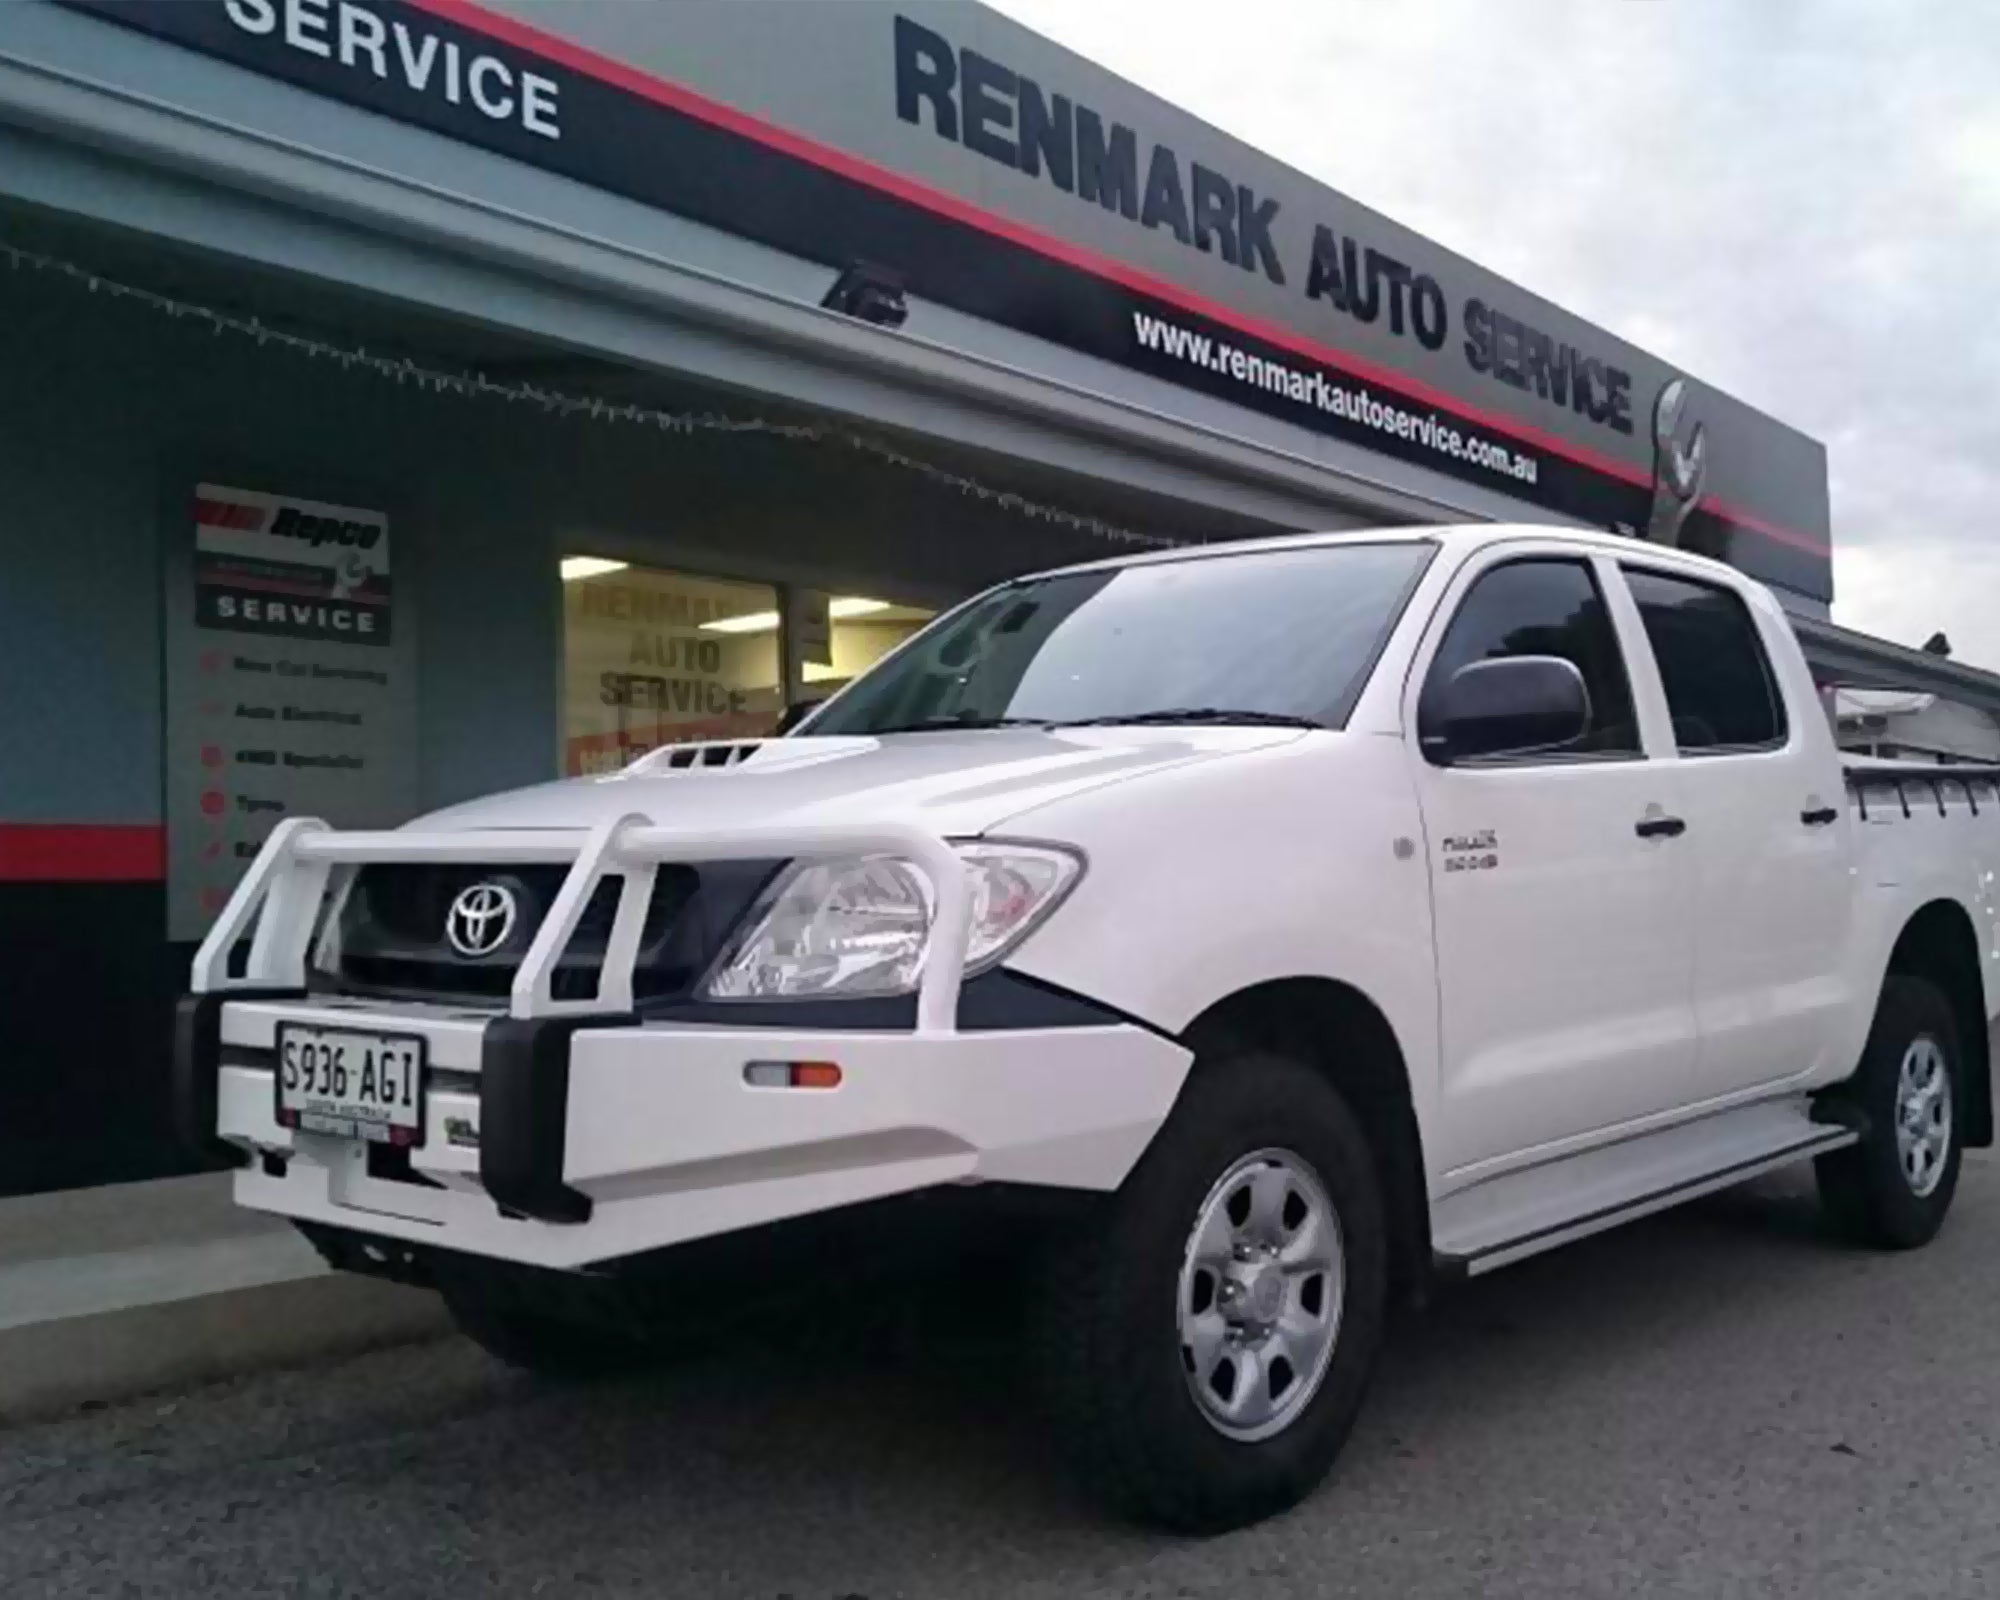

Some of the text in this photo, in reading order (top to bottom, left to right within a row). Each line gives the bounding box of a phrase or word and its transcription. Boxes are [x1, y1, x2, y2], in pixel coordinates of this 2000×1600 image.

[893, 14, 1635, 436] RENMARK AUTO SERVICE
[1133, 311, 1539, 485] www.renmarkautoservice.com.au
[270, 507, 381, 557] Repco
[217, 595, 376, 633] SERVICE
